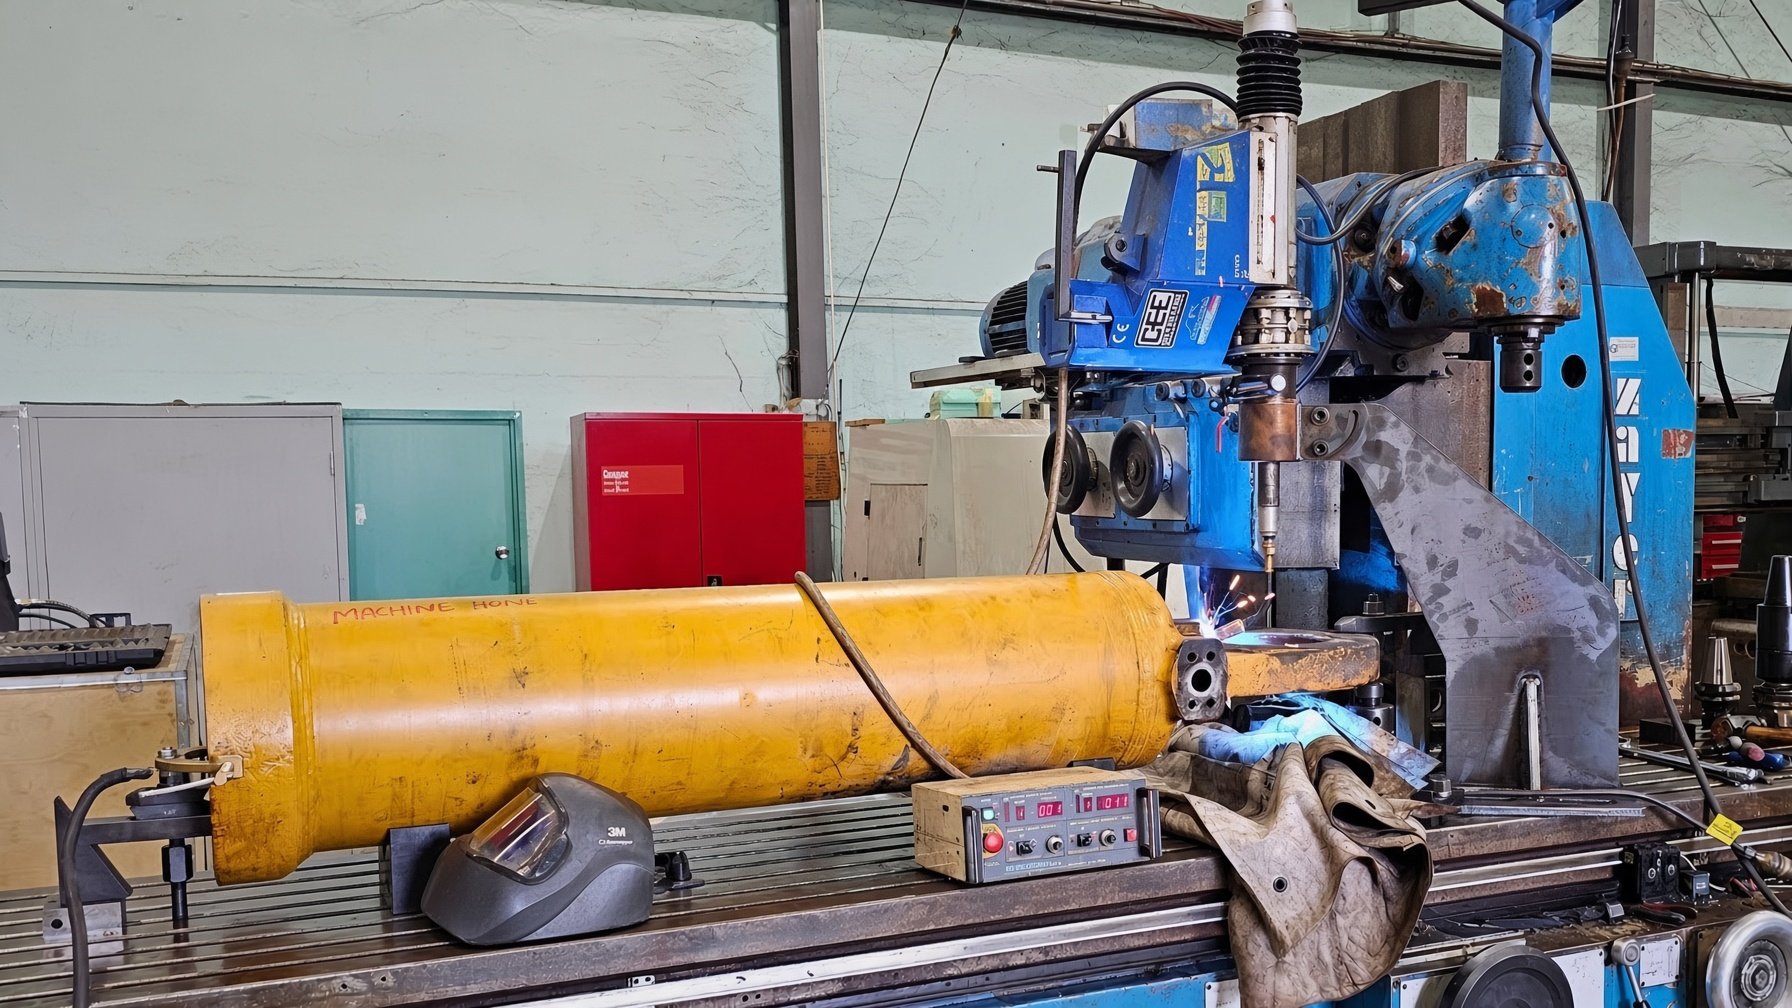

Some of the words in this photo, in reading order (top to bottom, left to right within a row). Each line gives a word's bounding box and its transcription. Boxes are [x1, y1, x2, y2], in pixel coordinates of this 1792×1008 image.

[333, 602, 454, 624] MACHINE
[472, 599, 537, 610] HONE
[607, 826, 626, 837] 3M
